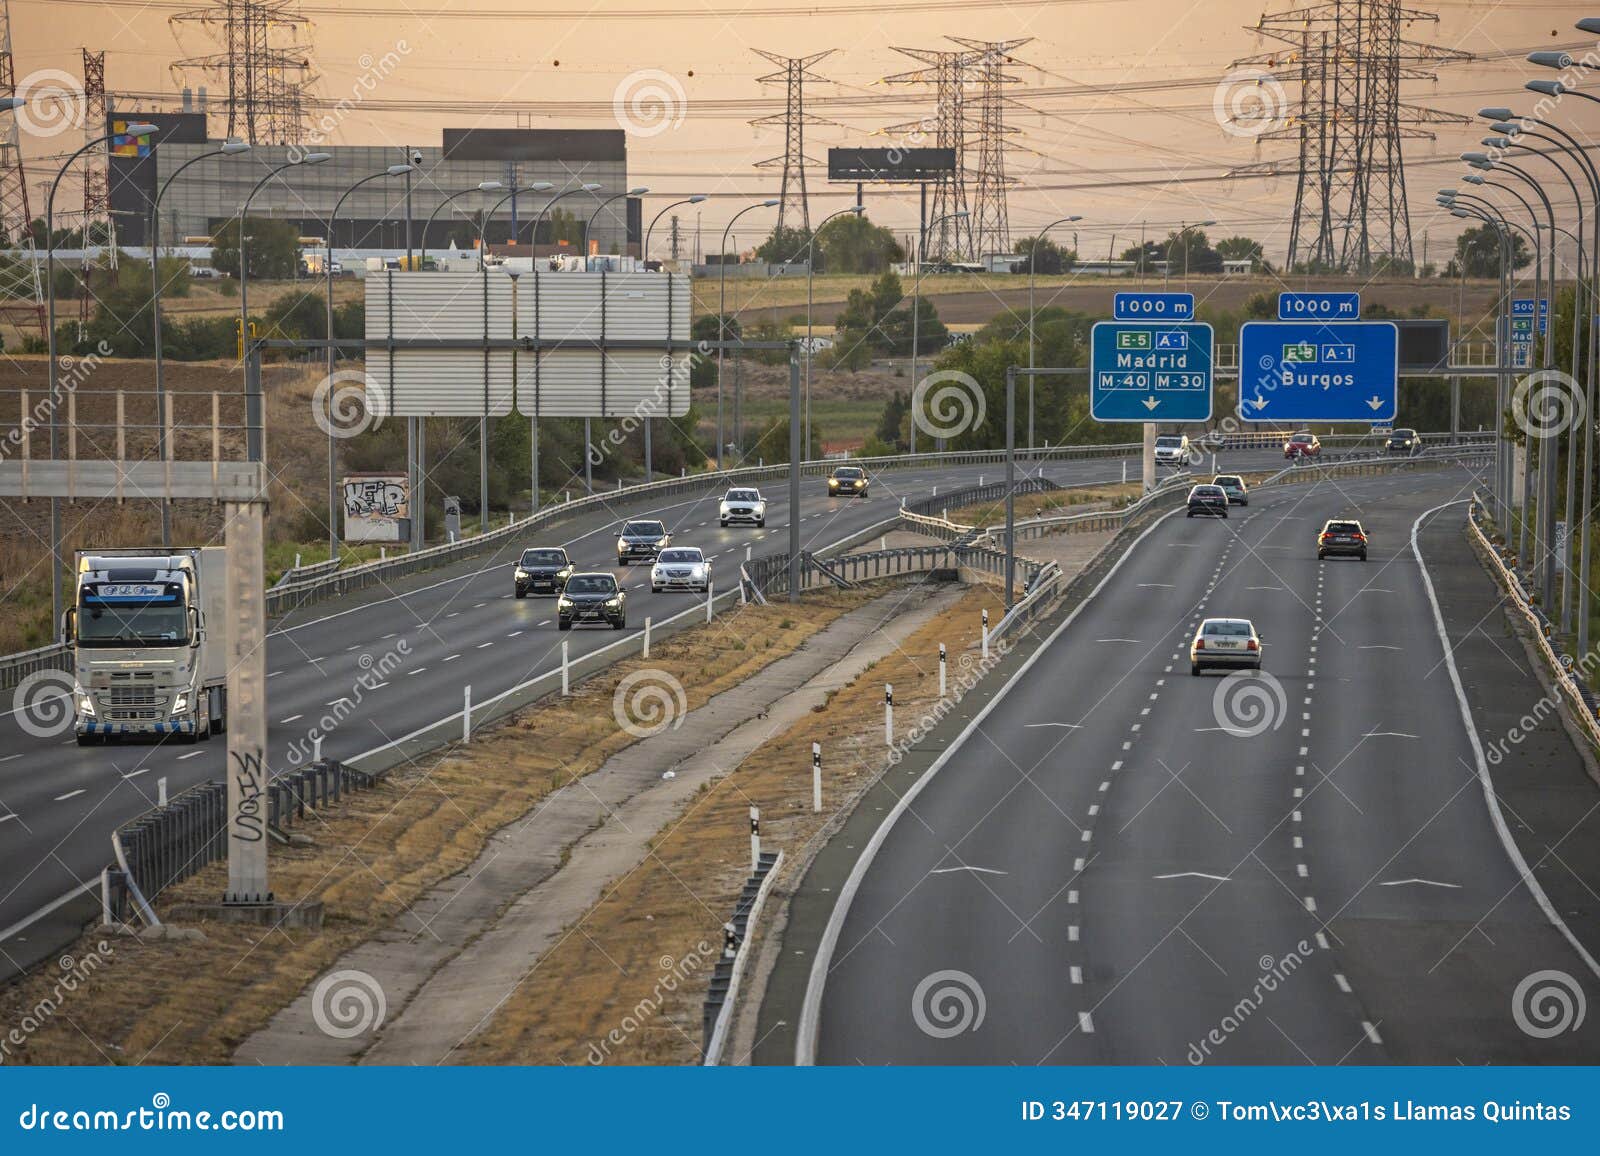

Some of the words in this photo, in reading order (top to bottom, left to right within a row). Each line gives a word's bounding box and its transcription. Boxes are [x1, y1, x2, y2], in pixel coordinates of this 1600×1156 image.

[1119, 300, 1165, 312] 1000
[1174, 303, 1187, 312] m
[1286, 300, 1331, 312] 1000
[1339, 303, 1352, 312] m
[1514, 303, 1534, 311] 500
[1121, 334, 1147, 346] E-5
[1159, 334, 1185, 346] A-1
[1326, 347, 1352, 359] A-1
[1117, 353, 1187, 368] Madrid
[1101, 375, 1147, 387] M-40
[1158, 375, 1202, 387] M-30
[1282, 371, 1354, 391] Burgos
